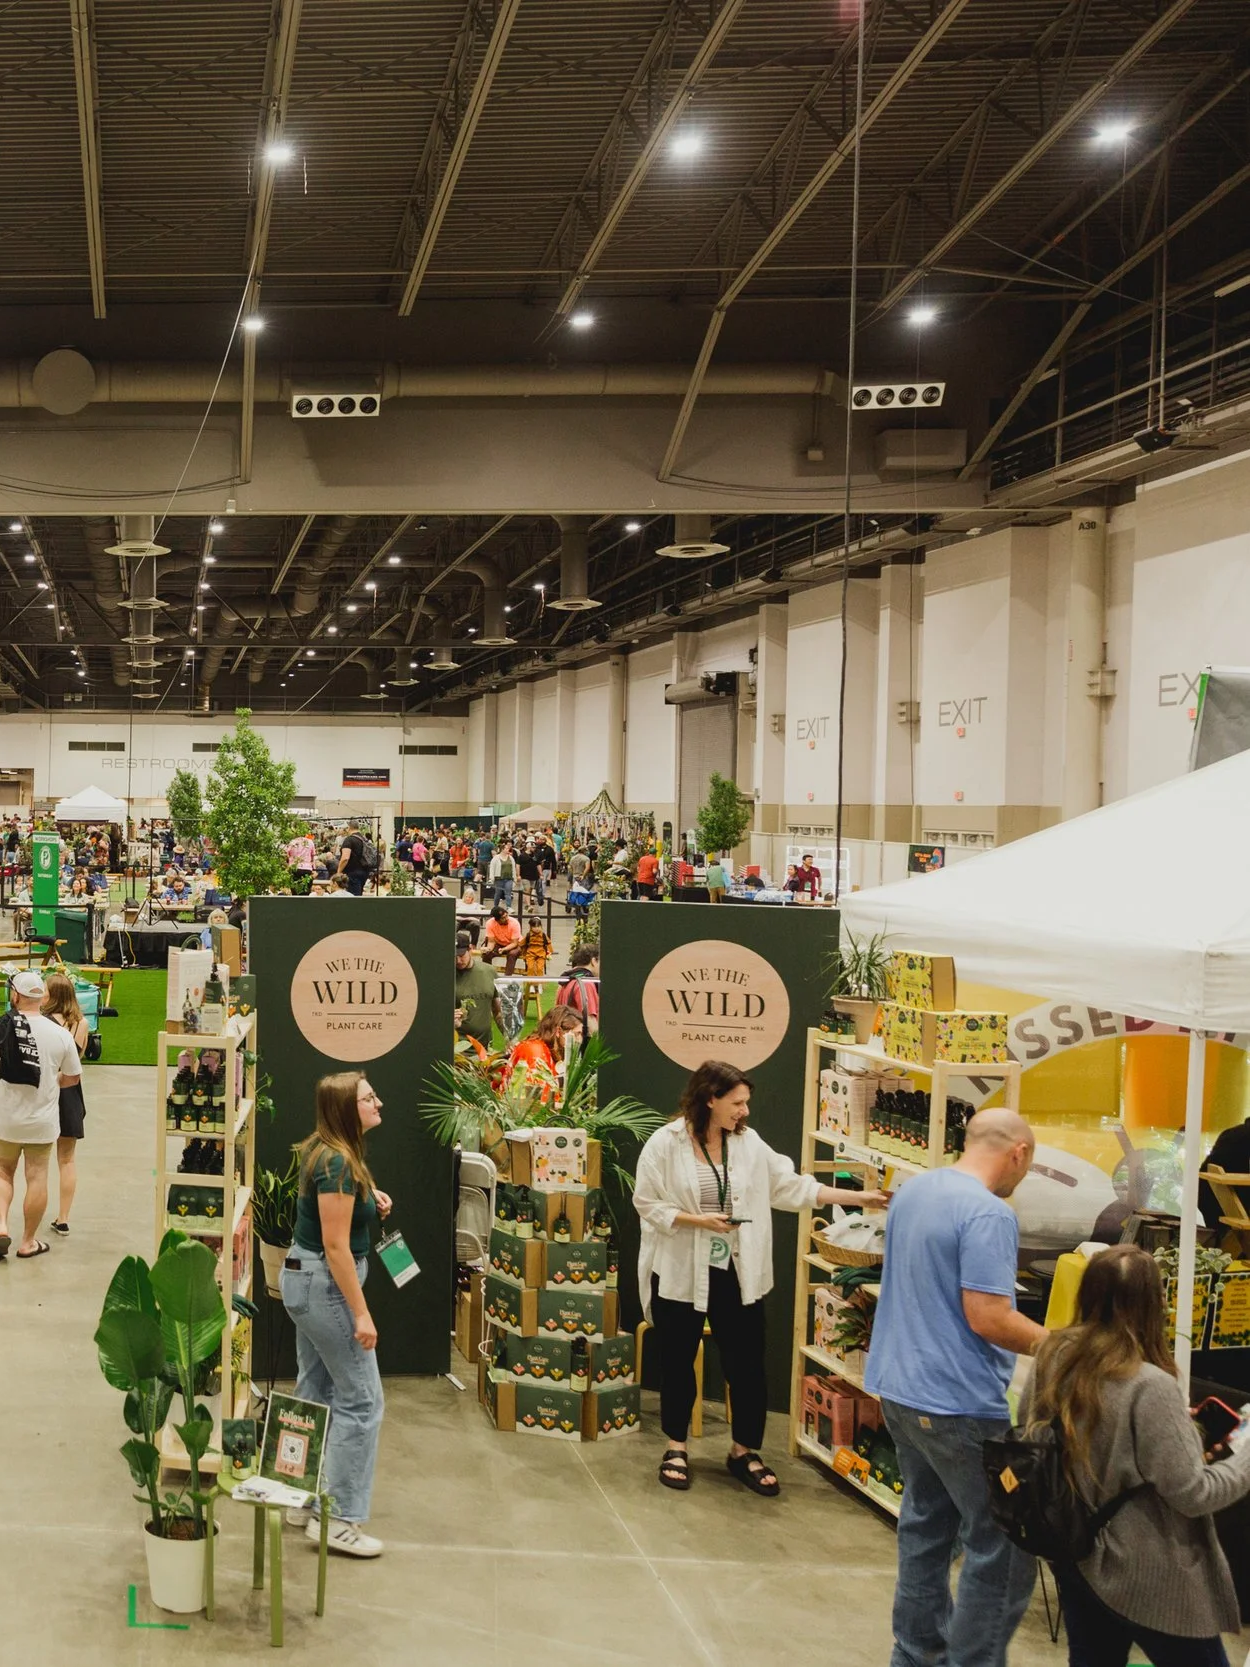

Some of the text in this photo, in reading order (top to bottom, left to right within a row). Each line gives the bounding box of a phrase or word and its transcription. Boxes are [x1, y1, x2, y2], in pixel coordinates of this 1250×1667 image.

[1078, 520, 1097, 531] A30
[939, 696, 988, 727] EXIT
[796, 716, 830, 740] EXIT
[101, 758, 215, 769] RESTROOMS
[325, 957, 385, 975] WE THE
[681, 967, 750, 987] WE THE
[312, 980, 398, 1005] WILD
[666, 989, 765, 1018] WILD
[326, 1022, 383, 1031] PLANT CARE
[681, 1032, 747, 1045] PLANT CARE
[279, 1408, 316, 1425] Follow Us
